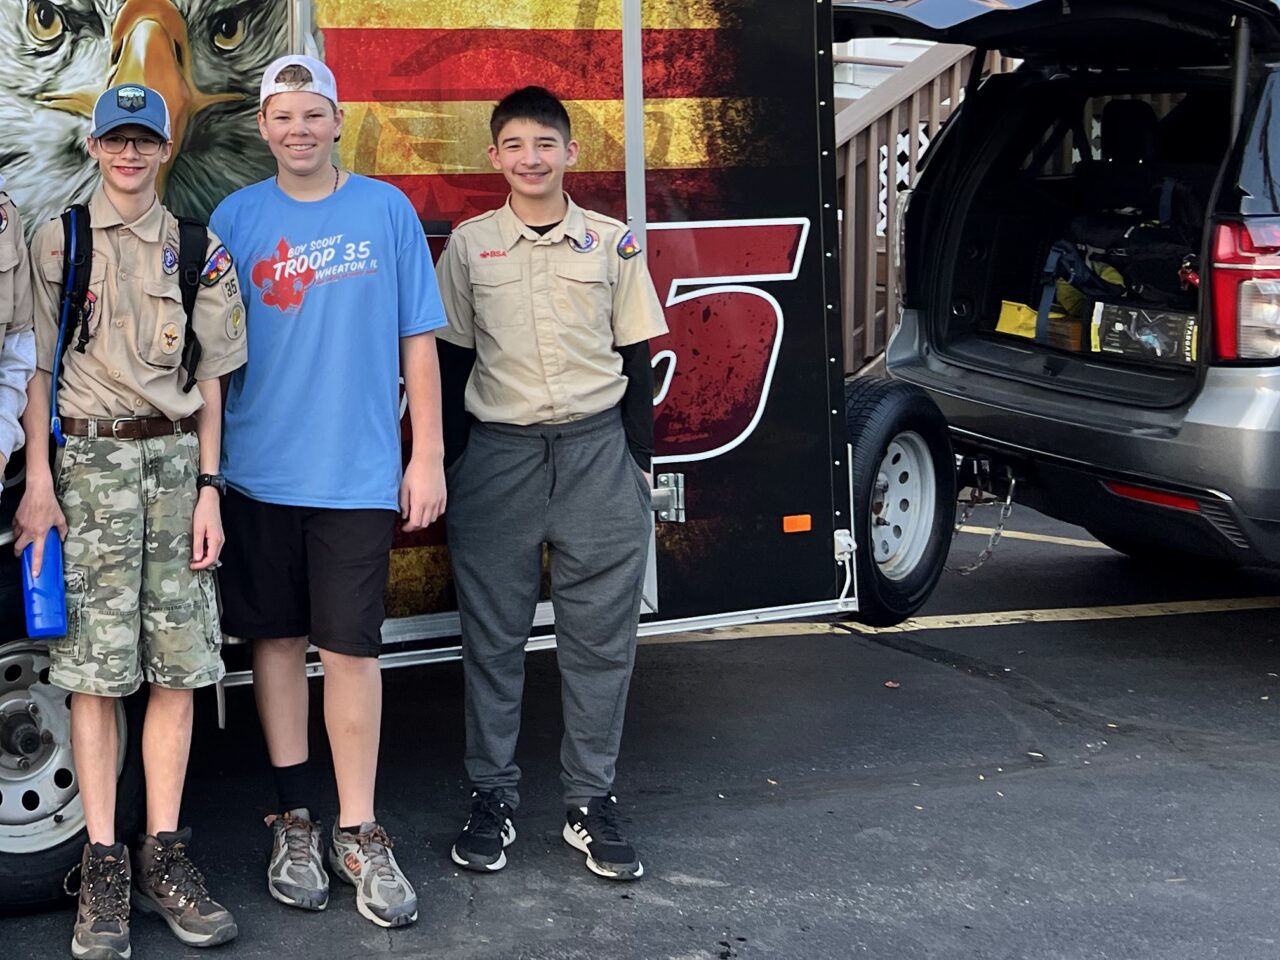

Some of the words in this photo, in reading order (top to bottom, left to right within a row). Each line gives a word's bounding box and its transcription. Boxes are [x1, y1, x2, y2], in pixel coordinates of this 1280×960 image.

[288, 244, 307, 258] BOY
[310, 234, 344, 251] SCOUT
[273, 248, 336, 281] TROOP
[343, 240, 371, 261] 35
[224, 279, 238, 298] 35
